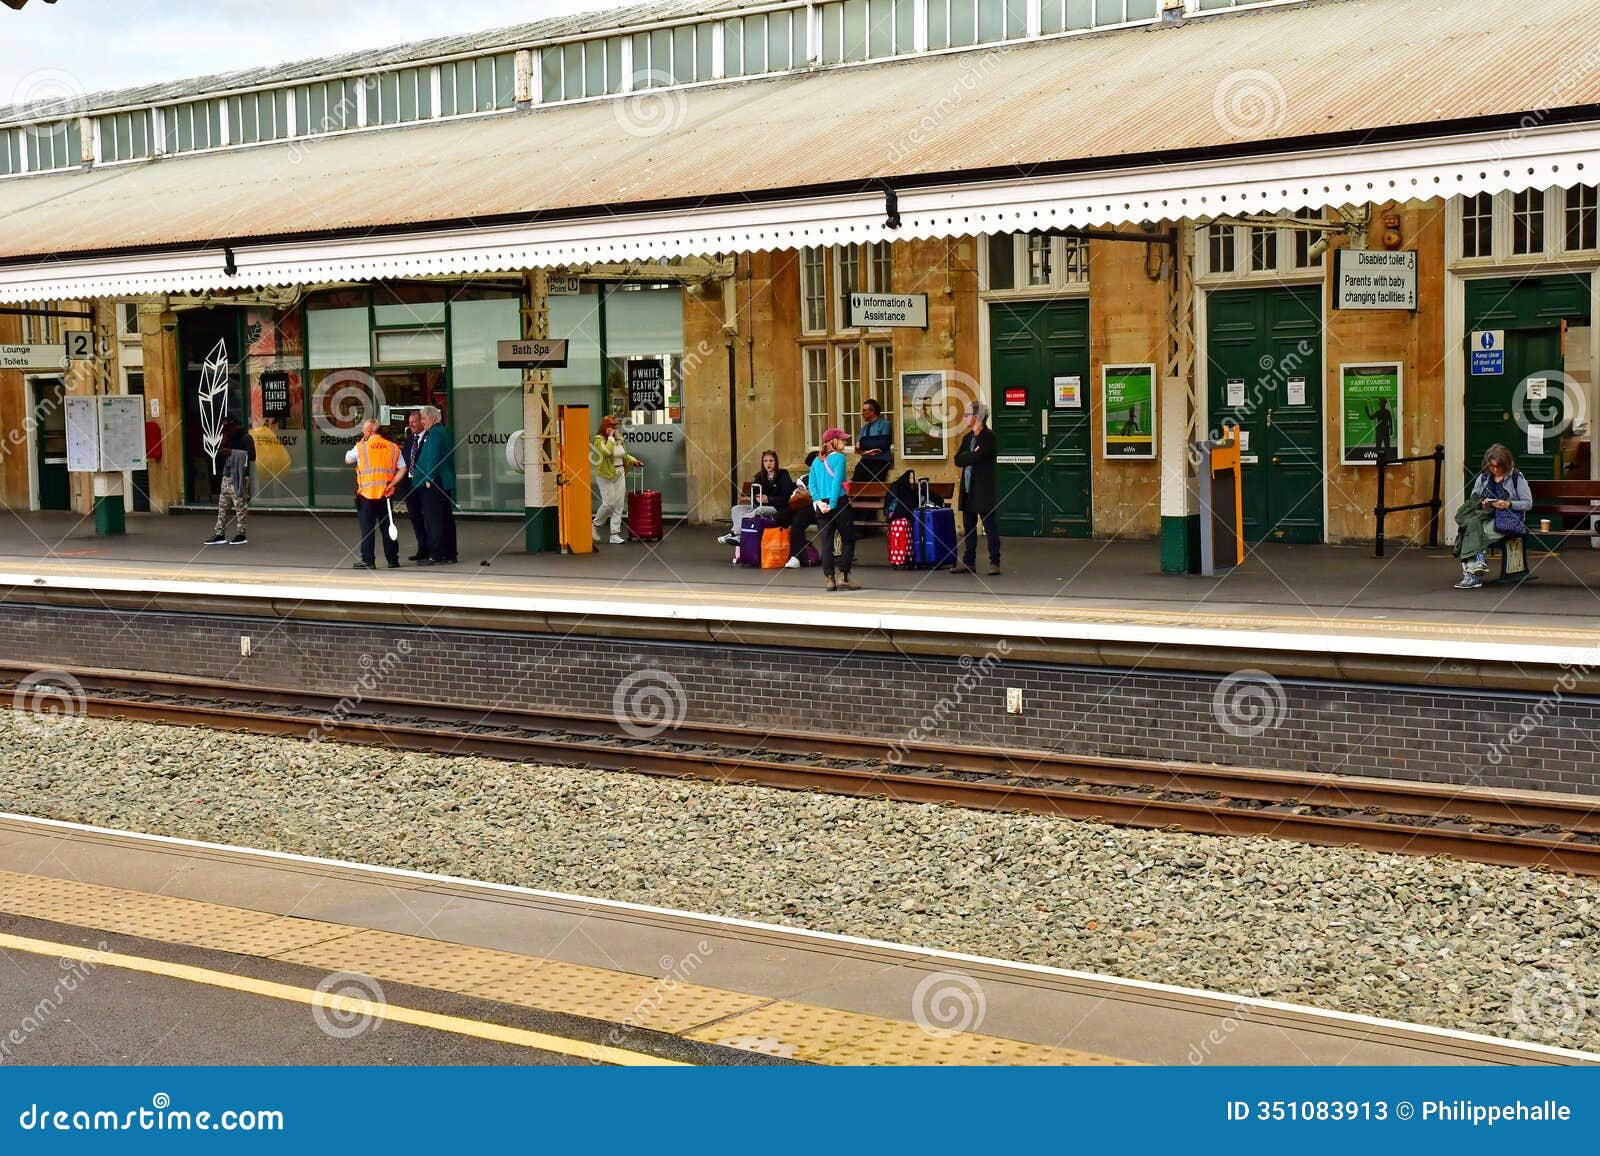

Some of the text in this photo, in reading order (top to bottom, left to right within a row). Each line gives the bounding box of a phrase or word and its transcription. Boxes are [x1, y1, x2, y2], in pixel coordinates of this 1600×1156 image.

[1358, 253, 1406, 265] Disabled toilet
[1345, 275, 1405, 288] Parents with baby
[863, 297, 913, 308] Information &
[1345, 291, 1406, 304] changing facilities
[864, 310, 906, 321] Assistance
[2, 346, 31, 355] Lounge
[74, 335, 88, 355] 2
[512, 344, 550, 356] Bath Spa
[637, 368, 660, 378] WHITE
[268, 381, 286, 390] WHITE
[632, 380, 660, 390] FEATHER
[265, 391, 287, 400] FEATHER
[632, 391, 656, 402] COFFEE
[266, 401, 284, 410] COFFEE
[320, 435, 363, 446] PREPARE
[468, 433, 510, 444] LOCALLY
[622, 431, 674, 443] PRODUCE
